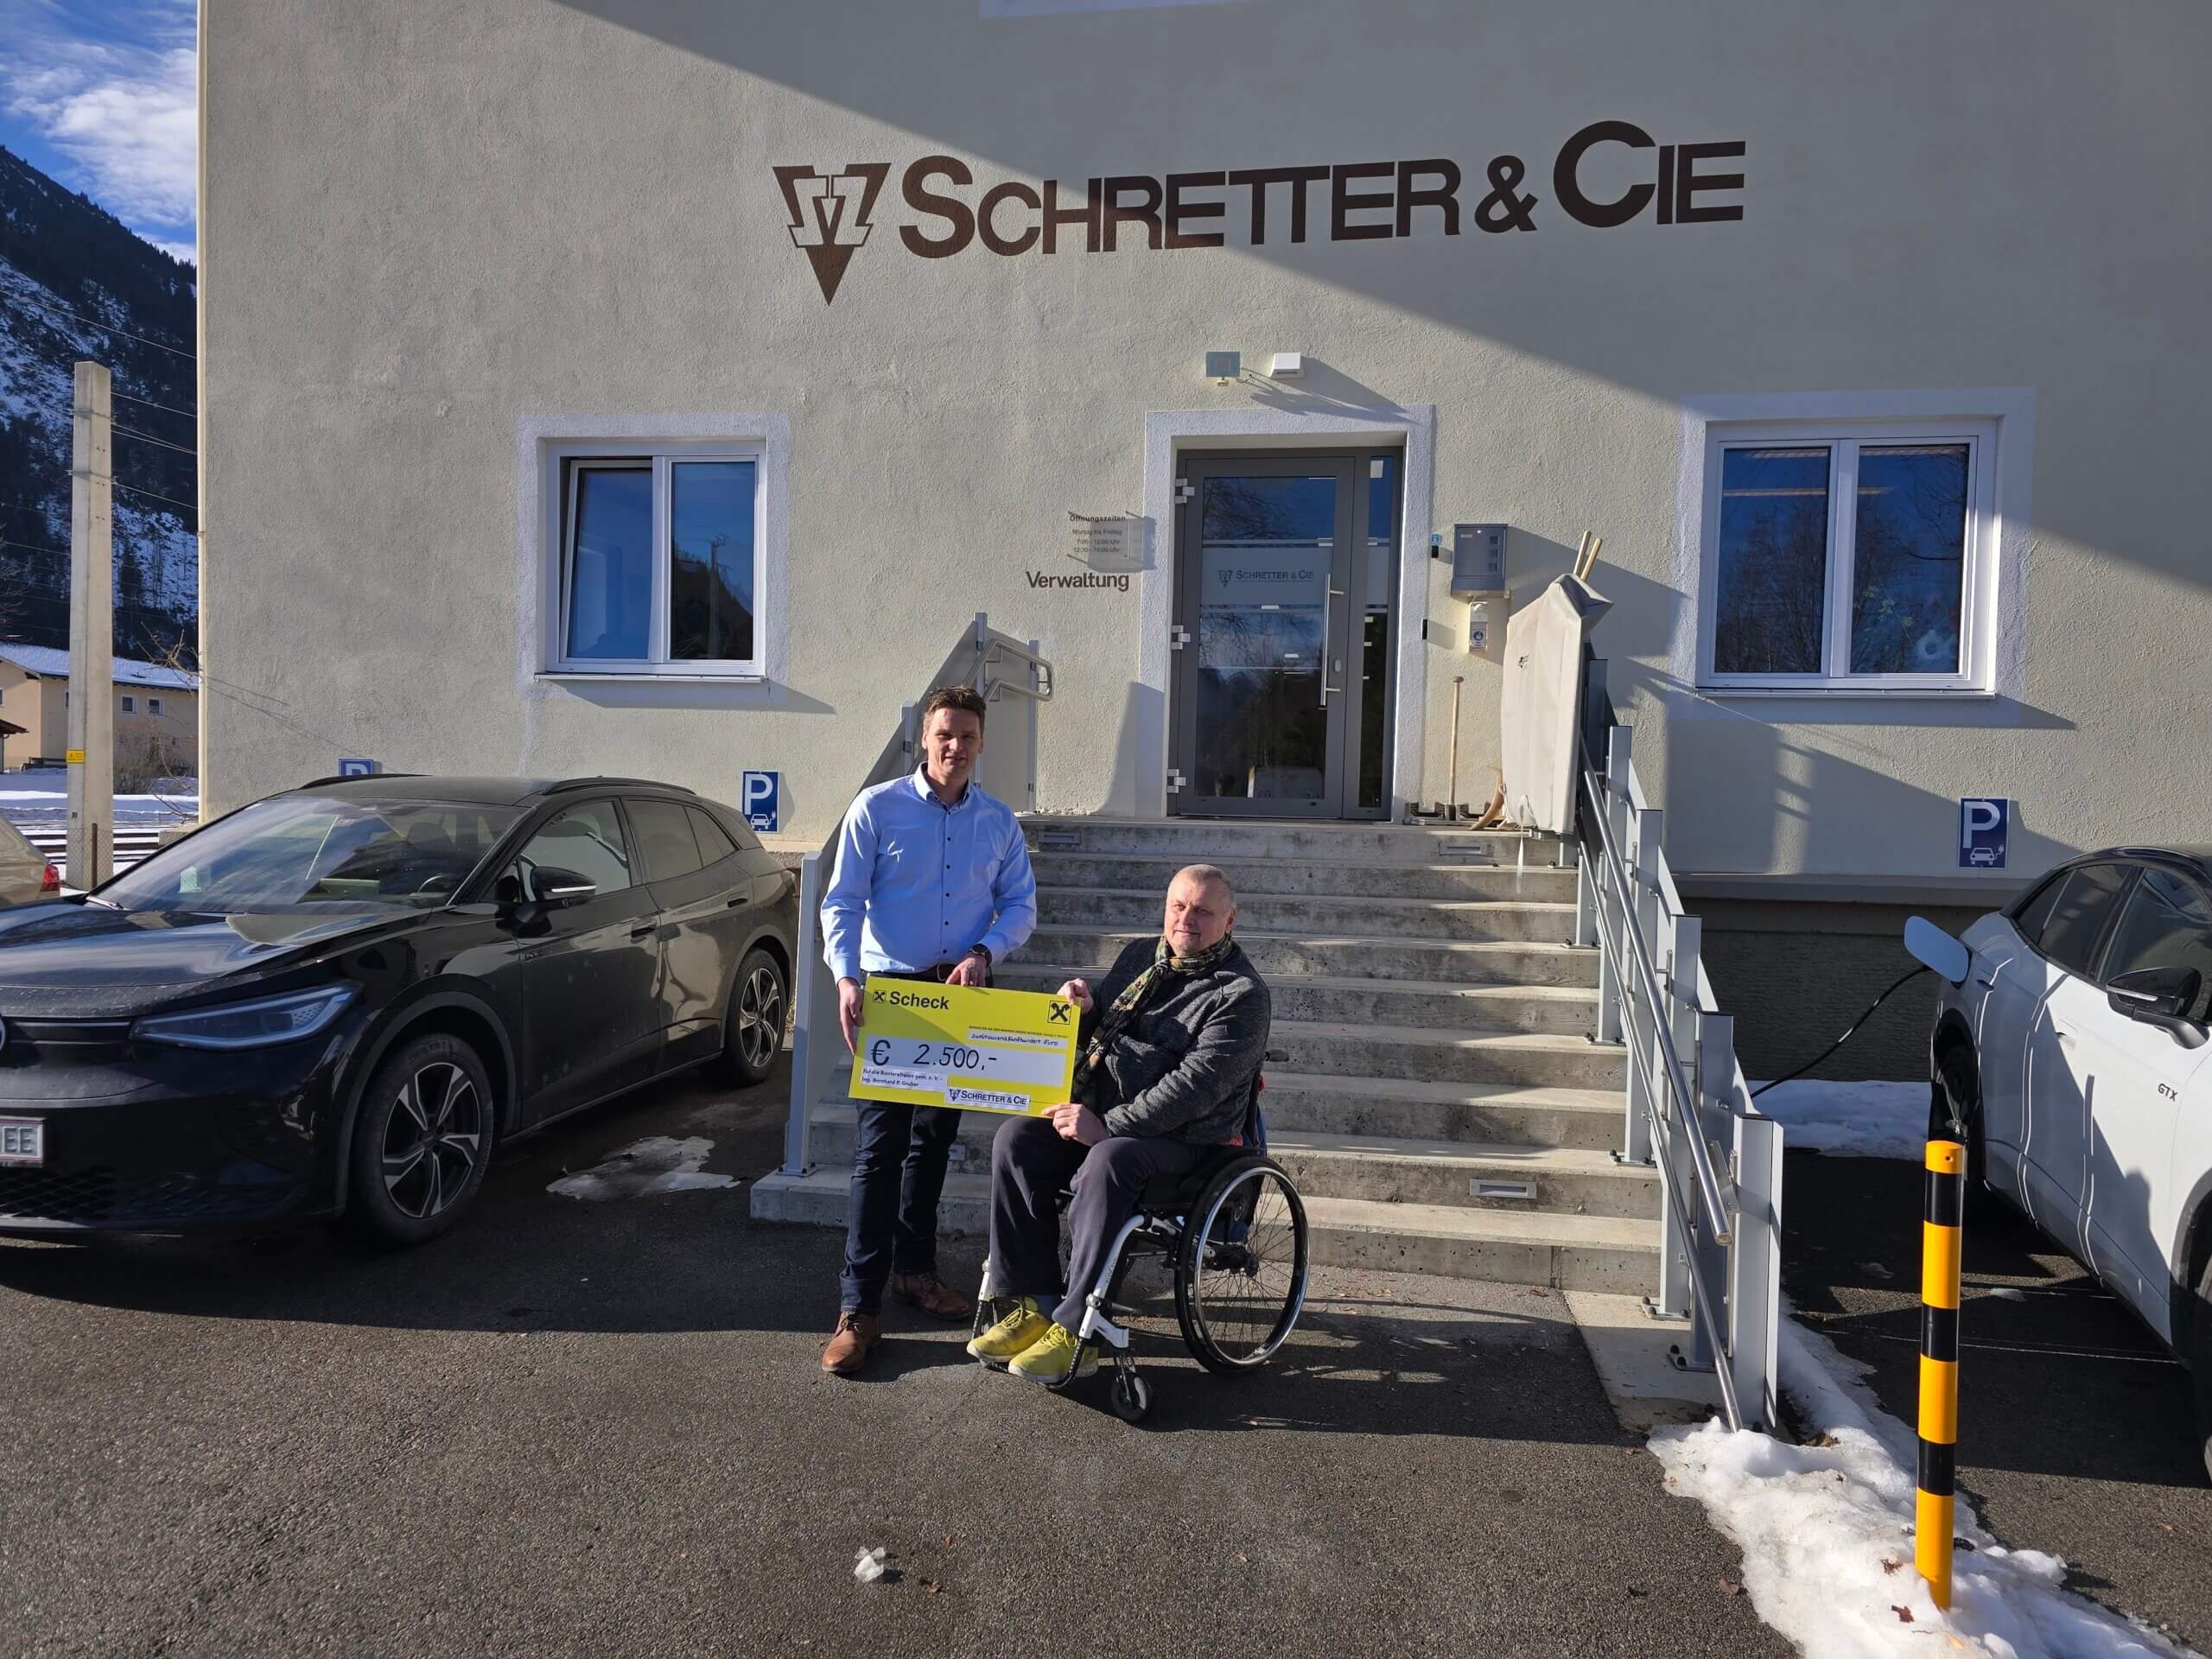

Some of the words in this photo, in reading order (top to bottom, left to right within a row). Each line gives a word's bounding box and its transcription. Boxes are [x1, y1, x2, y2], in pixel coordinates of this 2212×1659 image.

[899, 156, 1461, 258] SCHRETTER
[1474, 155, 1539, 233] &
[1026, 571, 1129, 592] Verwaltung
[745, 773, 773, 815] P
[1963, 801, 2000, 849] P
[889, 991, 950, 1009] Scheck
[871, 1039, 891, 1066] €
[2158, 1083, 2178, 1102] GTX
